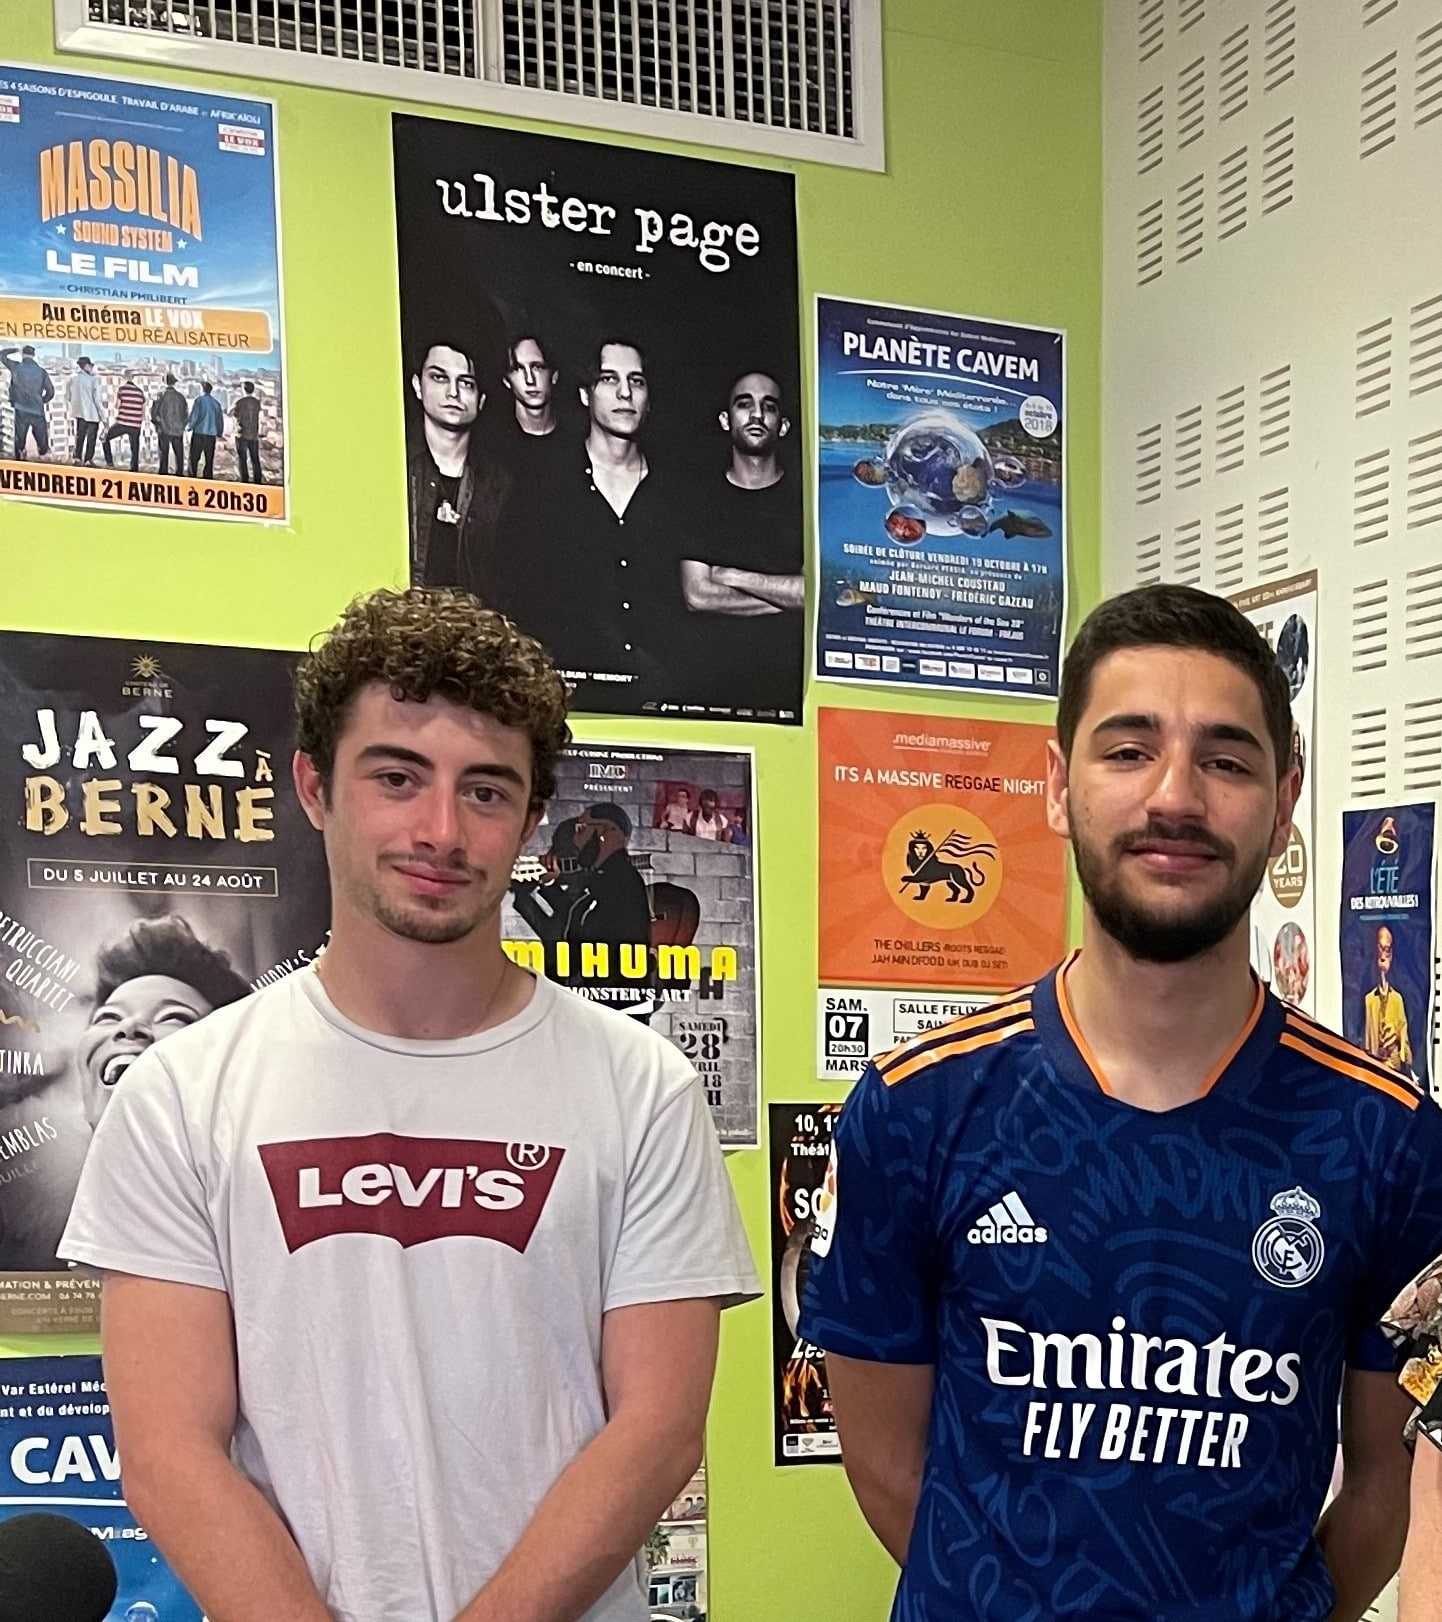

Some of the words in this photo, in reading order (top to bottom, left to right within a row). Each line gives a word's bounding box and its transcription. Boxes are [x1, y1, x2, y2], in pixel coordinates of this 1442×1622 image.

[10, 82, 16, 91] 4
[17, 82, 57, 96] SAISONS
[122, 96, 159, 110] TRAVAIL
[160, 101, 199, 116] D'ARABE
[40, 138, 202, 242] MASSILIA
[436, 173, 616, 235] ulster
[634, 207, 760, 273] page
[73, 219, 120, 247] SOUND
[121, 225, 173, 253] SYSTEM
[46, 249, 97, 277] LE
[104, 255, 199, 289] FILM
[577, 260, 593, 273] en
[595, 262, 643, 280] concert
[67, 284, 129, 300] CHRISTIAN
[130, 291, 188, 306] PHILIBERT
[42, 302, 66, 322] Au
[71, 304, 142, 326] cinéma
[144, 306, 165, 328] LE
[167, 308, 205, 330] VOX
[23, 321, 111, 342] PRÉSENCE
[116, 327, 138, 343] DU
[143, 327, 250, 349] RÉALISATEUR
[843, 331, 952, 370] PLANÈTE
[956, 349, 1040, 383] CAVEM
[866, 378, 899, 391] Notre
[886, 391, 912, 402] dans
[913, 395, 939, 406] tous
[1024, 417, 1053, 432] 2018
[0, 469, 96, 497] VENDREDI
[101, 479, 123, 500] 21
[128, 481, 183, 506] AVRIL
[187, 486, 200, 508] à
[204, 488, 268, 514] 20h30
[843, 542, 874, 556] SOIRÉE
[876, 546, 887, 557] DE
[927, 550, 969, 566] VENDREDI
[983, 555, 1021, 573] OCTOBRE
[889, 570, 955, 588] JEAN-MICHEL
[957, 576, 1006, 593] COUSTEAU
[859, 580, 890, 594] MAUD
[892, 586, 942, 600] FONTENOY
[951, 589, 996, 605] FRÉDÉRIC
[998, 595, 1034, 610] GAZEAU
[556, 669, 587, 680] LBUM
[122, 686, 173, 699] BERNE
[22, 708, 249, 778] JAZZ
[583, 783, 633, 793] PRÉSENTENT
[863, 768, 875, 784] A
[877, 769, 942, 789] MASSIVE
[945, 774, 1001, 793] REGGAE
[1003, 778, 1046, 796] NIGHT
[24, 774, 275, 842] BERNE
[1272, 843, 1304, 876] 20
[43, 867, 68, 882] DU
[73, 870, 85, 882] 5
[89, 870, 158, 885] JUILLET
[164, 873, 186, 887] AU
[192, 874, 211, 888] 24
[216, 873, 263, 889] AOÛT
[1273, 876, 1304, 890] YEARS
[873, 938, 892, 950] THE
[893, 939, 941, 953] CHILLERS
[871, 954, 891, 965] JAH
[5, 958, 76, 1013] QUARTET
[658, 988, 692, 1003] ART
[825, 997, 868, 1012] SAM.
[898, 1003, 939, 1015] SALLE
[679, 1021, 721, 1032] SAMEDI
[829, 1014, 864, 1039] 07
[680, 1033, 721, 1060] 28
[830, 1043, 864, 1054] 20h30
[694, 1061, 722, 1072] RIL
[825, 1059, 868, 1072] MARS
[966, 1223, 1048, 1244] adidas
[979, 1315, 1302, 1407] Emirates
[1, 1384, 24, 1396] Var
[29, 1382, 77, 1395] Estérel
[18, 1406, 32, 1417] et
[37, 1405, 54, 1417] du
[1023, 1401, 1097, 1460] FLY
[1099, 1403, 1250, 1469] BETTER
